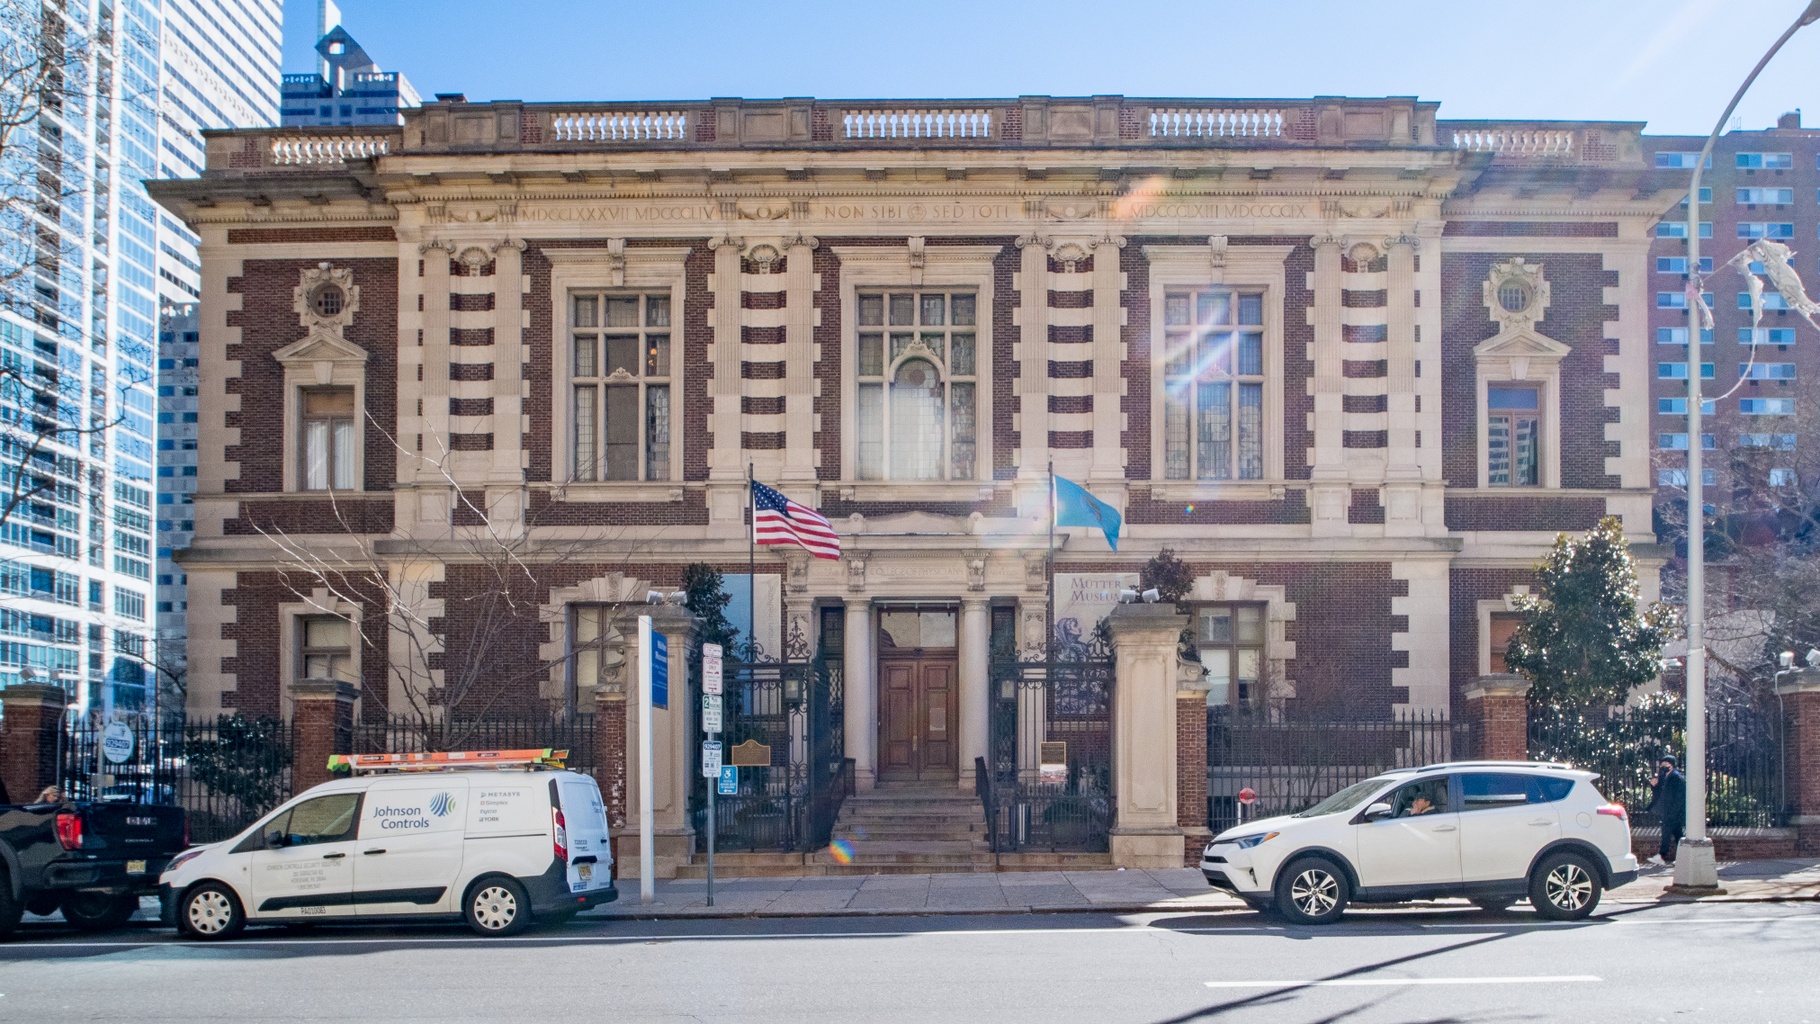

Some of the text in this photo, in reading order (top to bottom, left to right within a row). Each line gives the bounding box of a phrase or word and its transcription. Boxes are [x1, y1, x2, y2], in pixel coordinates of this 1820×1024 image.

[824, 204, 1009, 219] NON SIBI SED TOTI
[704, 697, 709, 708] 2
[373, 806, 421, 819] Johnson
[381, 817, 430, 830] Controls
